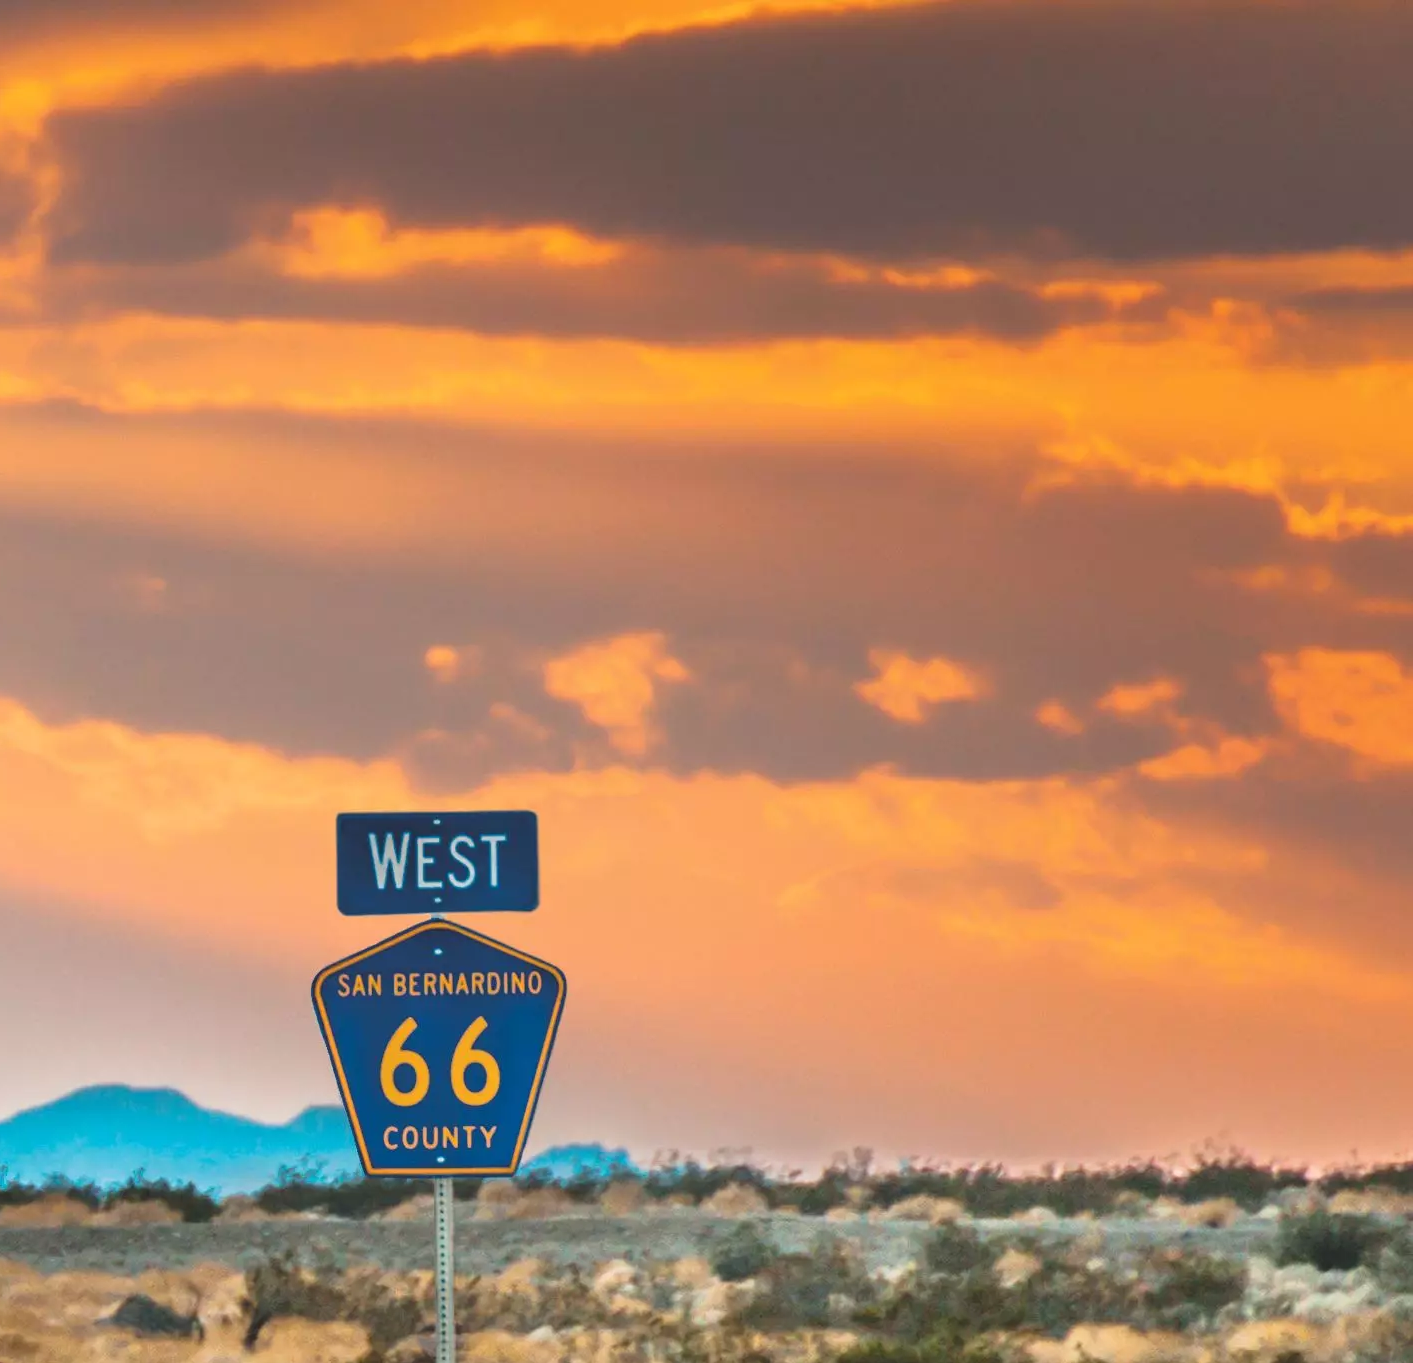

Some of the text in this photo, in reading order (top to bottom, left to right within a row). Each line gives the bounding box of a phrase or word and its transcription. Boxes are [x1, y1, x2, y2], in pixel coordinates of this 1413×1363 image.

[368, 832, 507, 889] WEST
[337, 971, 542, 997] SAN BERNARDINO
[380, 1015, 501, 1107] 66
[383, 1125, 497, 1150] COUNTY
